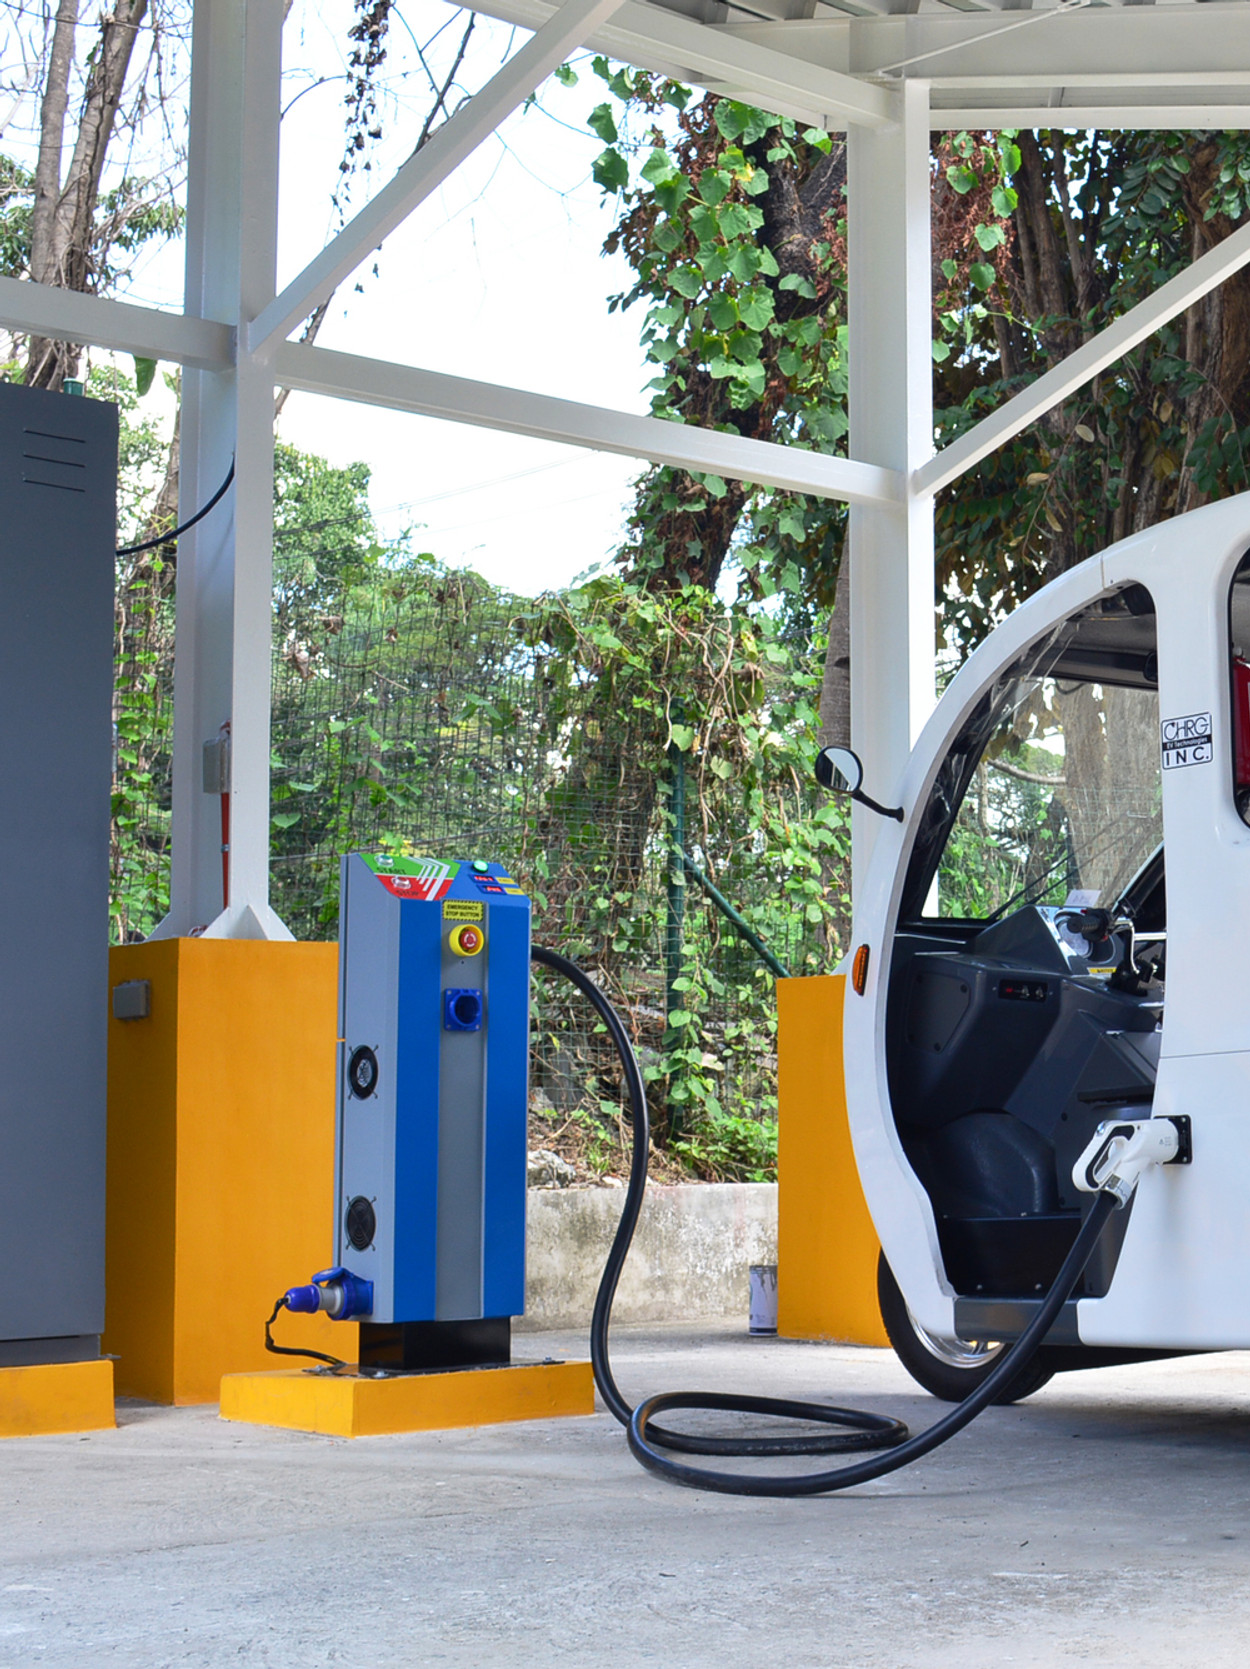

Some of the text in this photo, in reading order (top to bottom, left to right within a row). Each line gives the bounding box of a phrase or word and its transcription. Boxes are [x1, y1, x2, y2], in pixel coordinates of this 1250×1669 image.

[1164, 716, 1209, 741] CHRG
[1174, 737, 1208, 747] Technologies
[1166, 746, 1209, 766] INC.
